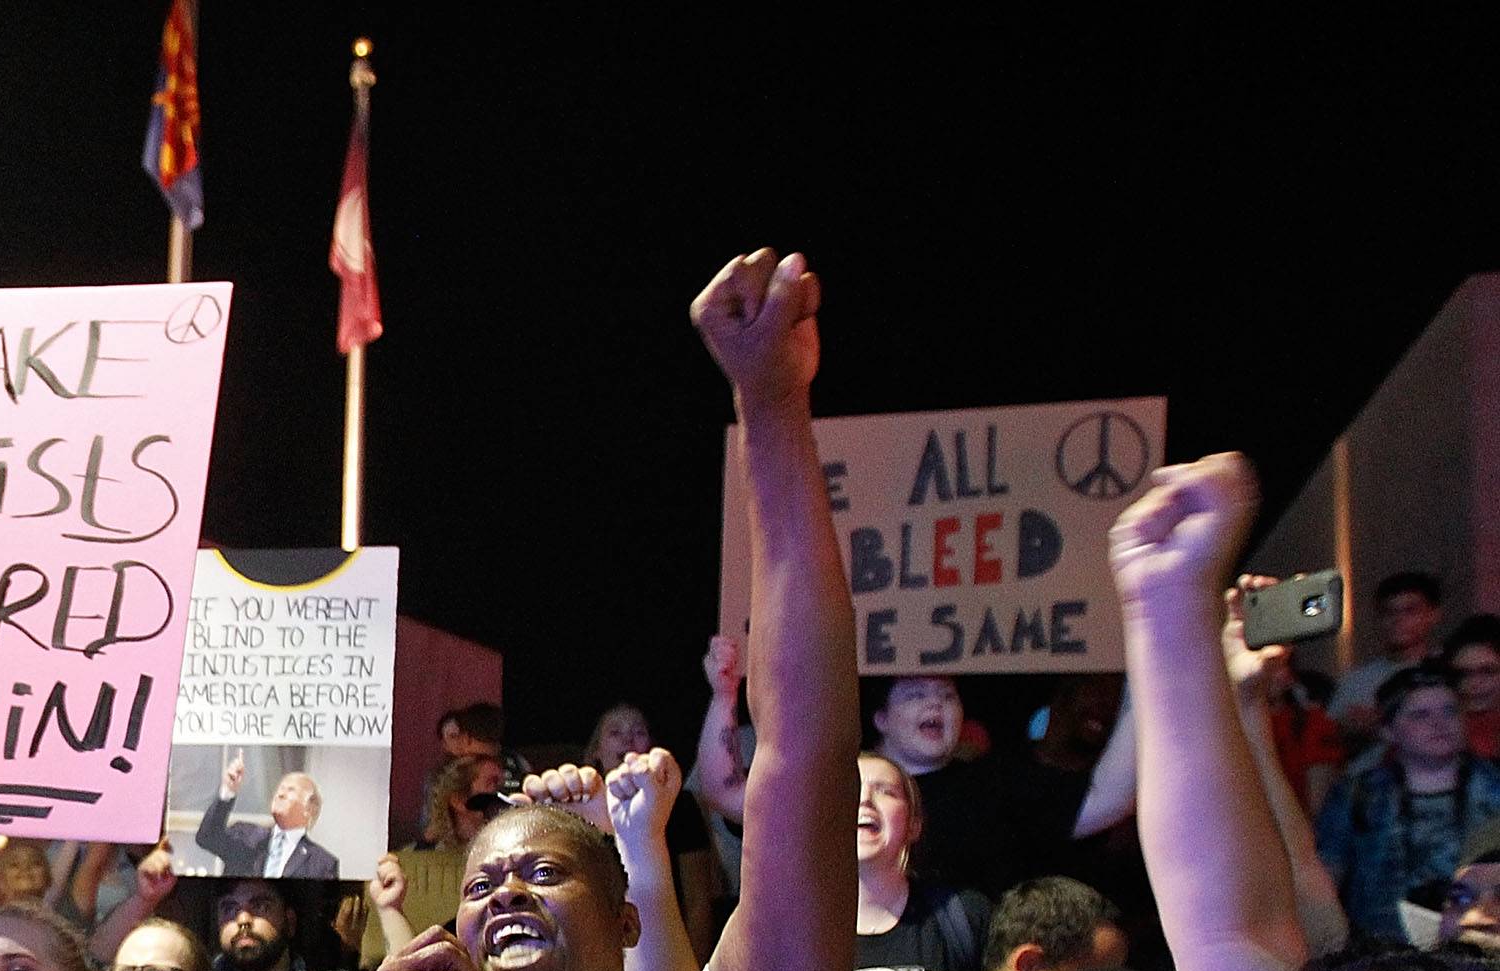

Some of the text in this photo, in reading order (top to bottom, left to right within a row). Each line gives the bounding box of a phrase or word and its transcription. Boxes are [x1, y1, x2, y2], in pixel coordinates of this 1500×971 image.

[908, 424, 1010, 505] ALL
[850, 508, 1064, 594] BLEED
[231, 596, 275, 621] YOU
[193, 623, 367, 649] BLIND TO THE
[920, 601, 1088, 665] SAME
[185, 654, 375, 678] INJUSTICES IN
[179, 683, 386, 711] AMERICA BEFORE,
[177, 712, 389, 739] YOU SURE ARE NOW
